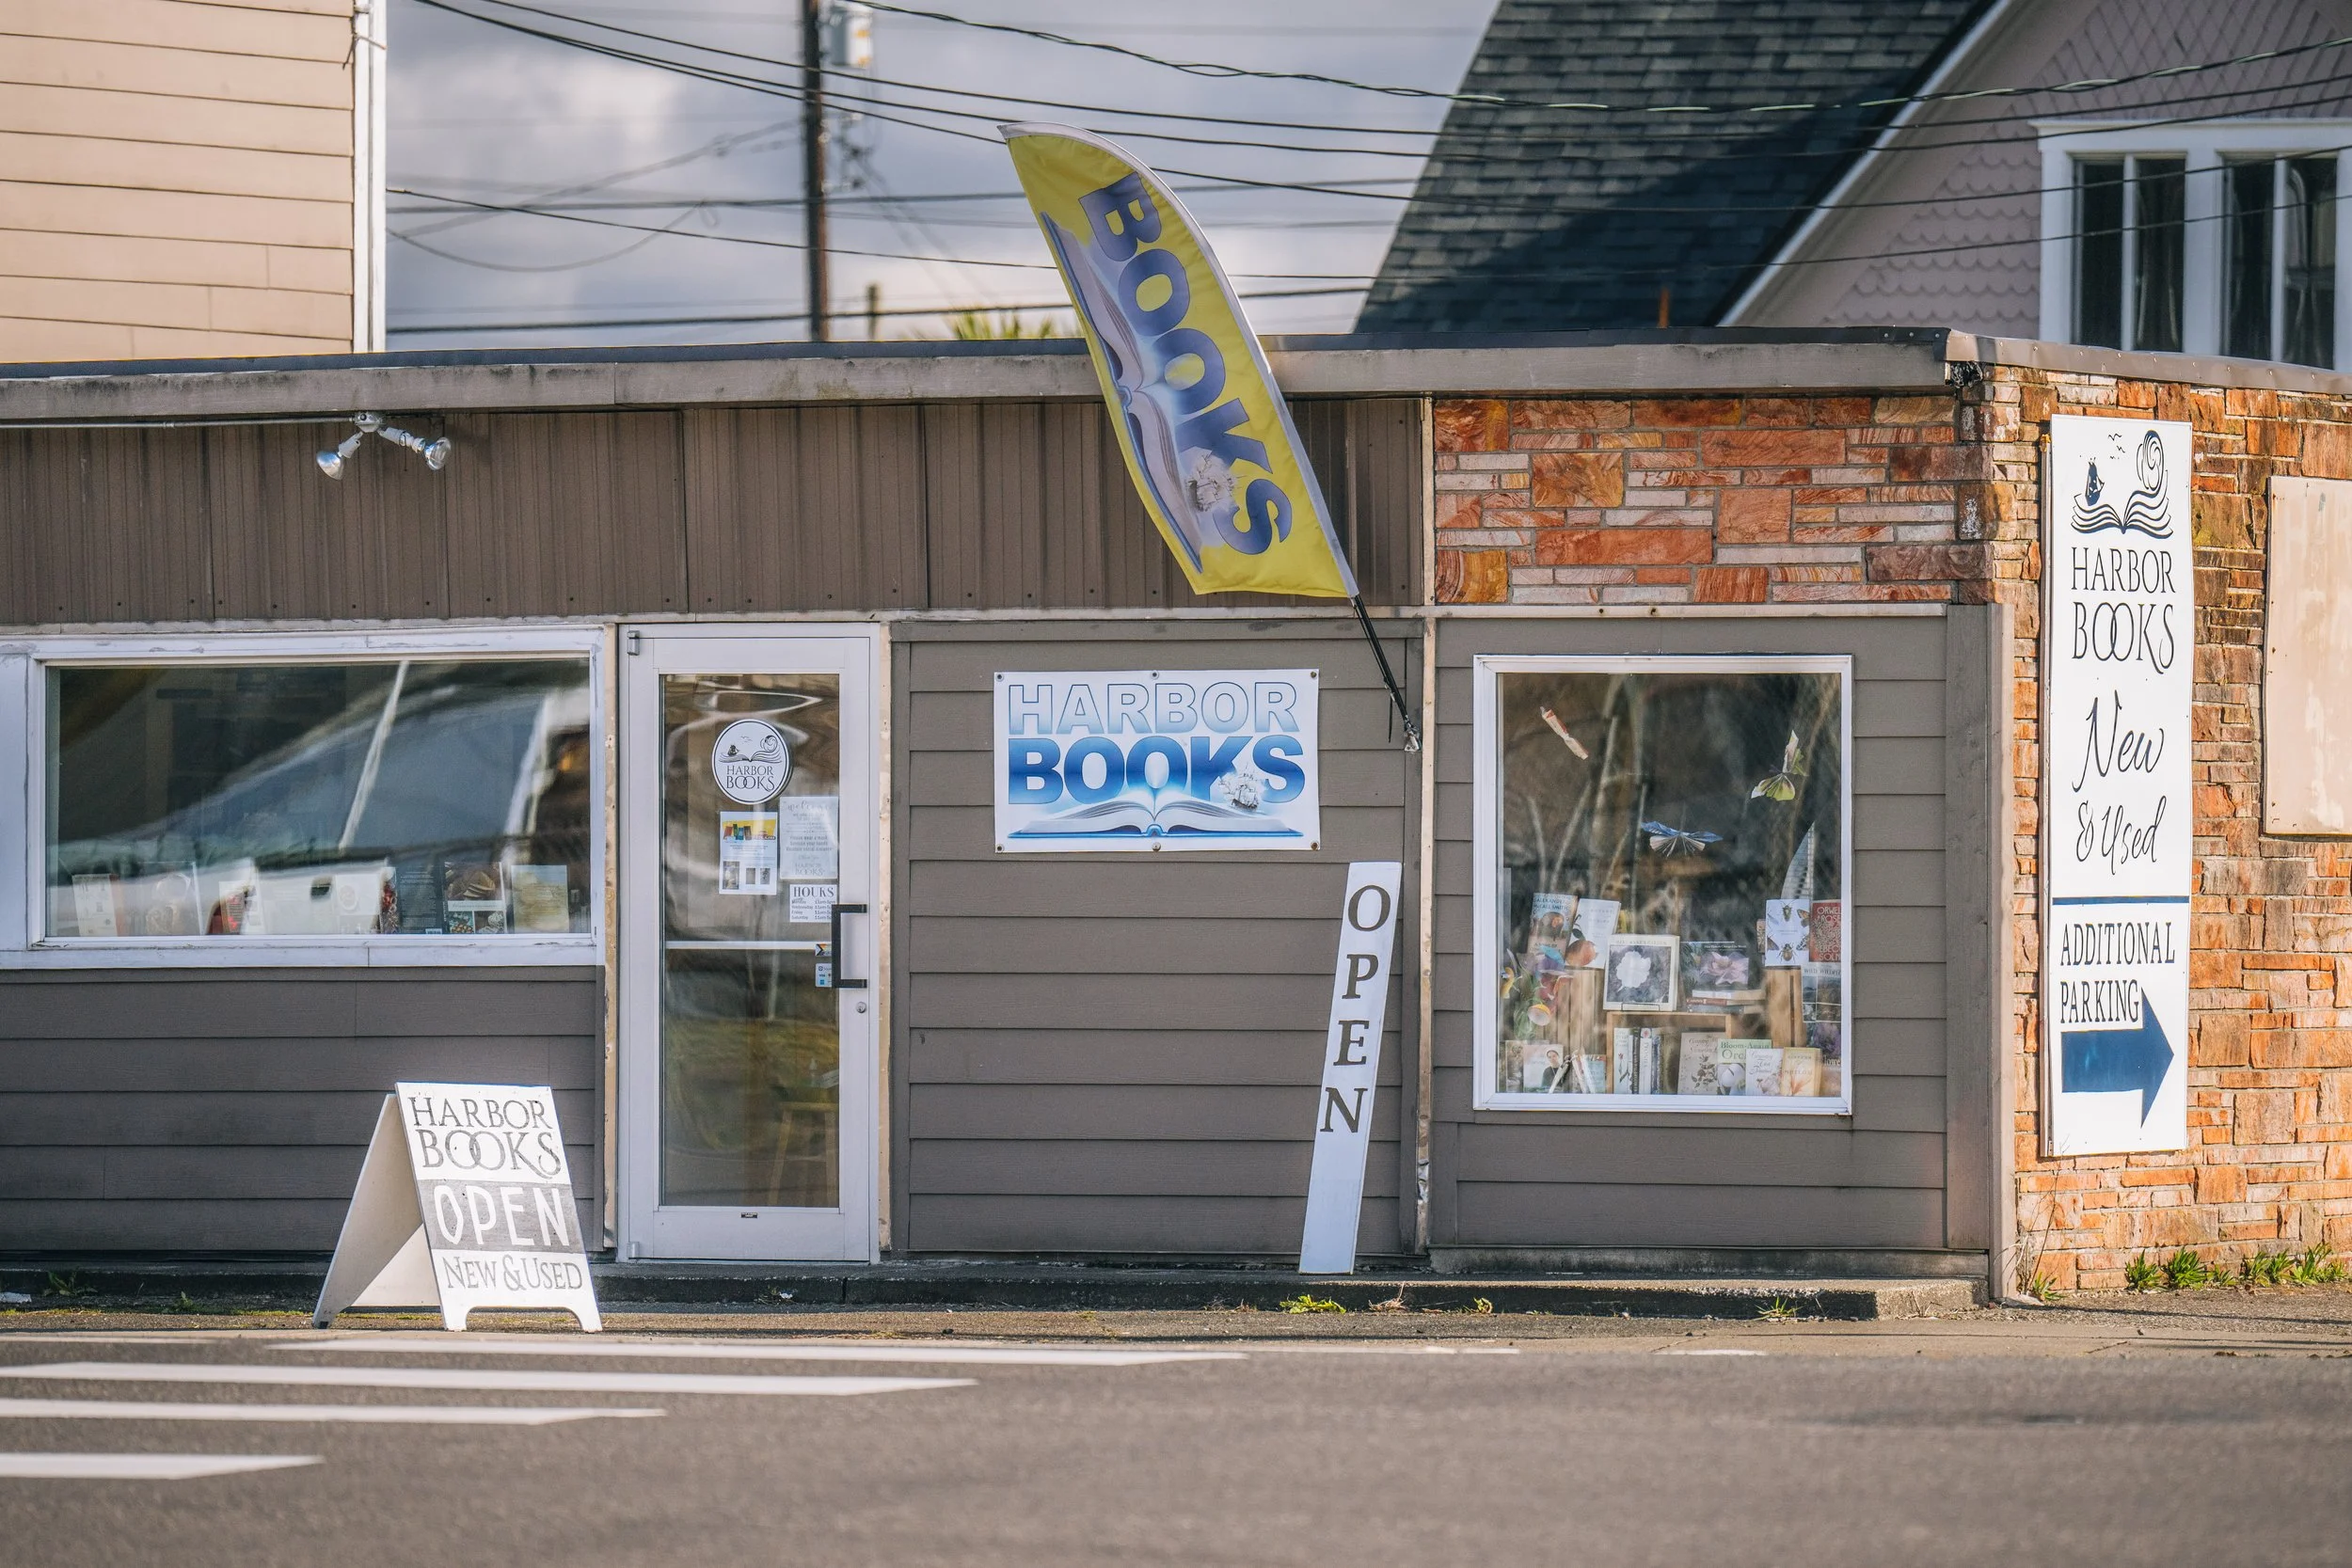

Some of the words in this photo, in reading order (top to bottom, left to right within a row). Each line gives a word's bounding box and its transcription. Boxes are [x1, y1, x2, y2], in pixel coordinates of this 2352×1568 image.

[1078, 170, 1293, 556] BOOKS
[2071, 546, 2176, 594] HARBOR
[2072, 602, 2174, 674] BOOKS
[1009, 681, 1300, 736] HARBOR
[2073, 689, 2165, 792] New
[726, 765, 774, 775] HARBOR
[726, 776, 775, 792] BOOKS
[1009, 735, 1306, 804] BOOKS
[2100, 795, 2168, 876] Used
[2060, 921, 2175, 966] ADDITIONAL
[1320, 885, 1391, 1133] OPEN
[2060, 978, 2139, 1023] PARKING
[408, 1096, 553, 1130] HARBOR
[415, 1129, 562, 1180] BOOKS
[433, 1184, 570, 1246] OPEN
[442, 1256, 497, 1290] NEW
[526, 1258, 583, 1290] USED
